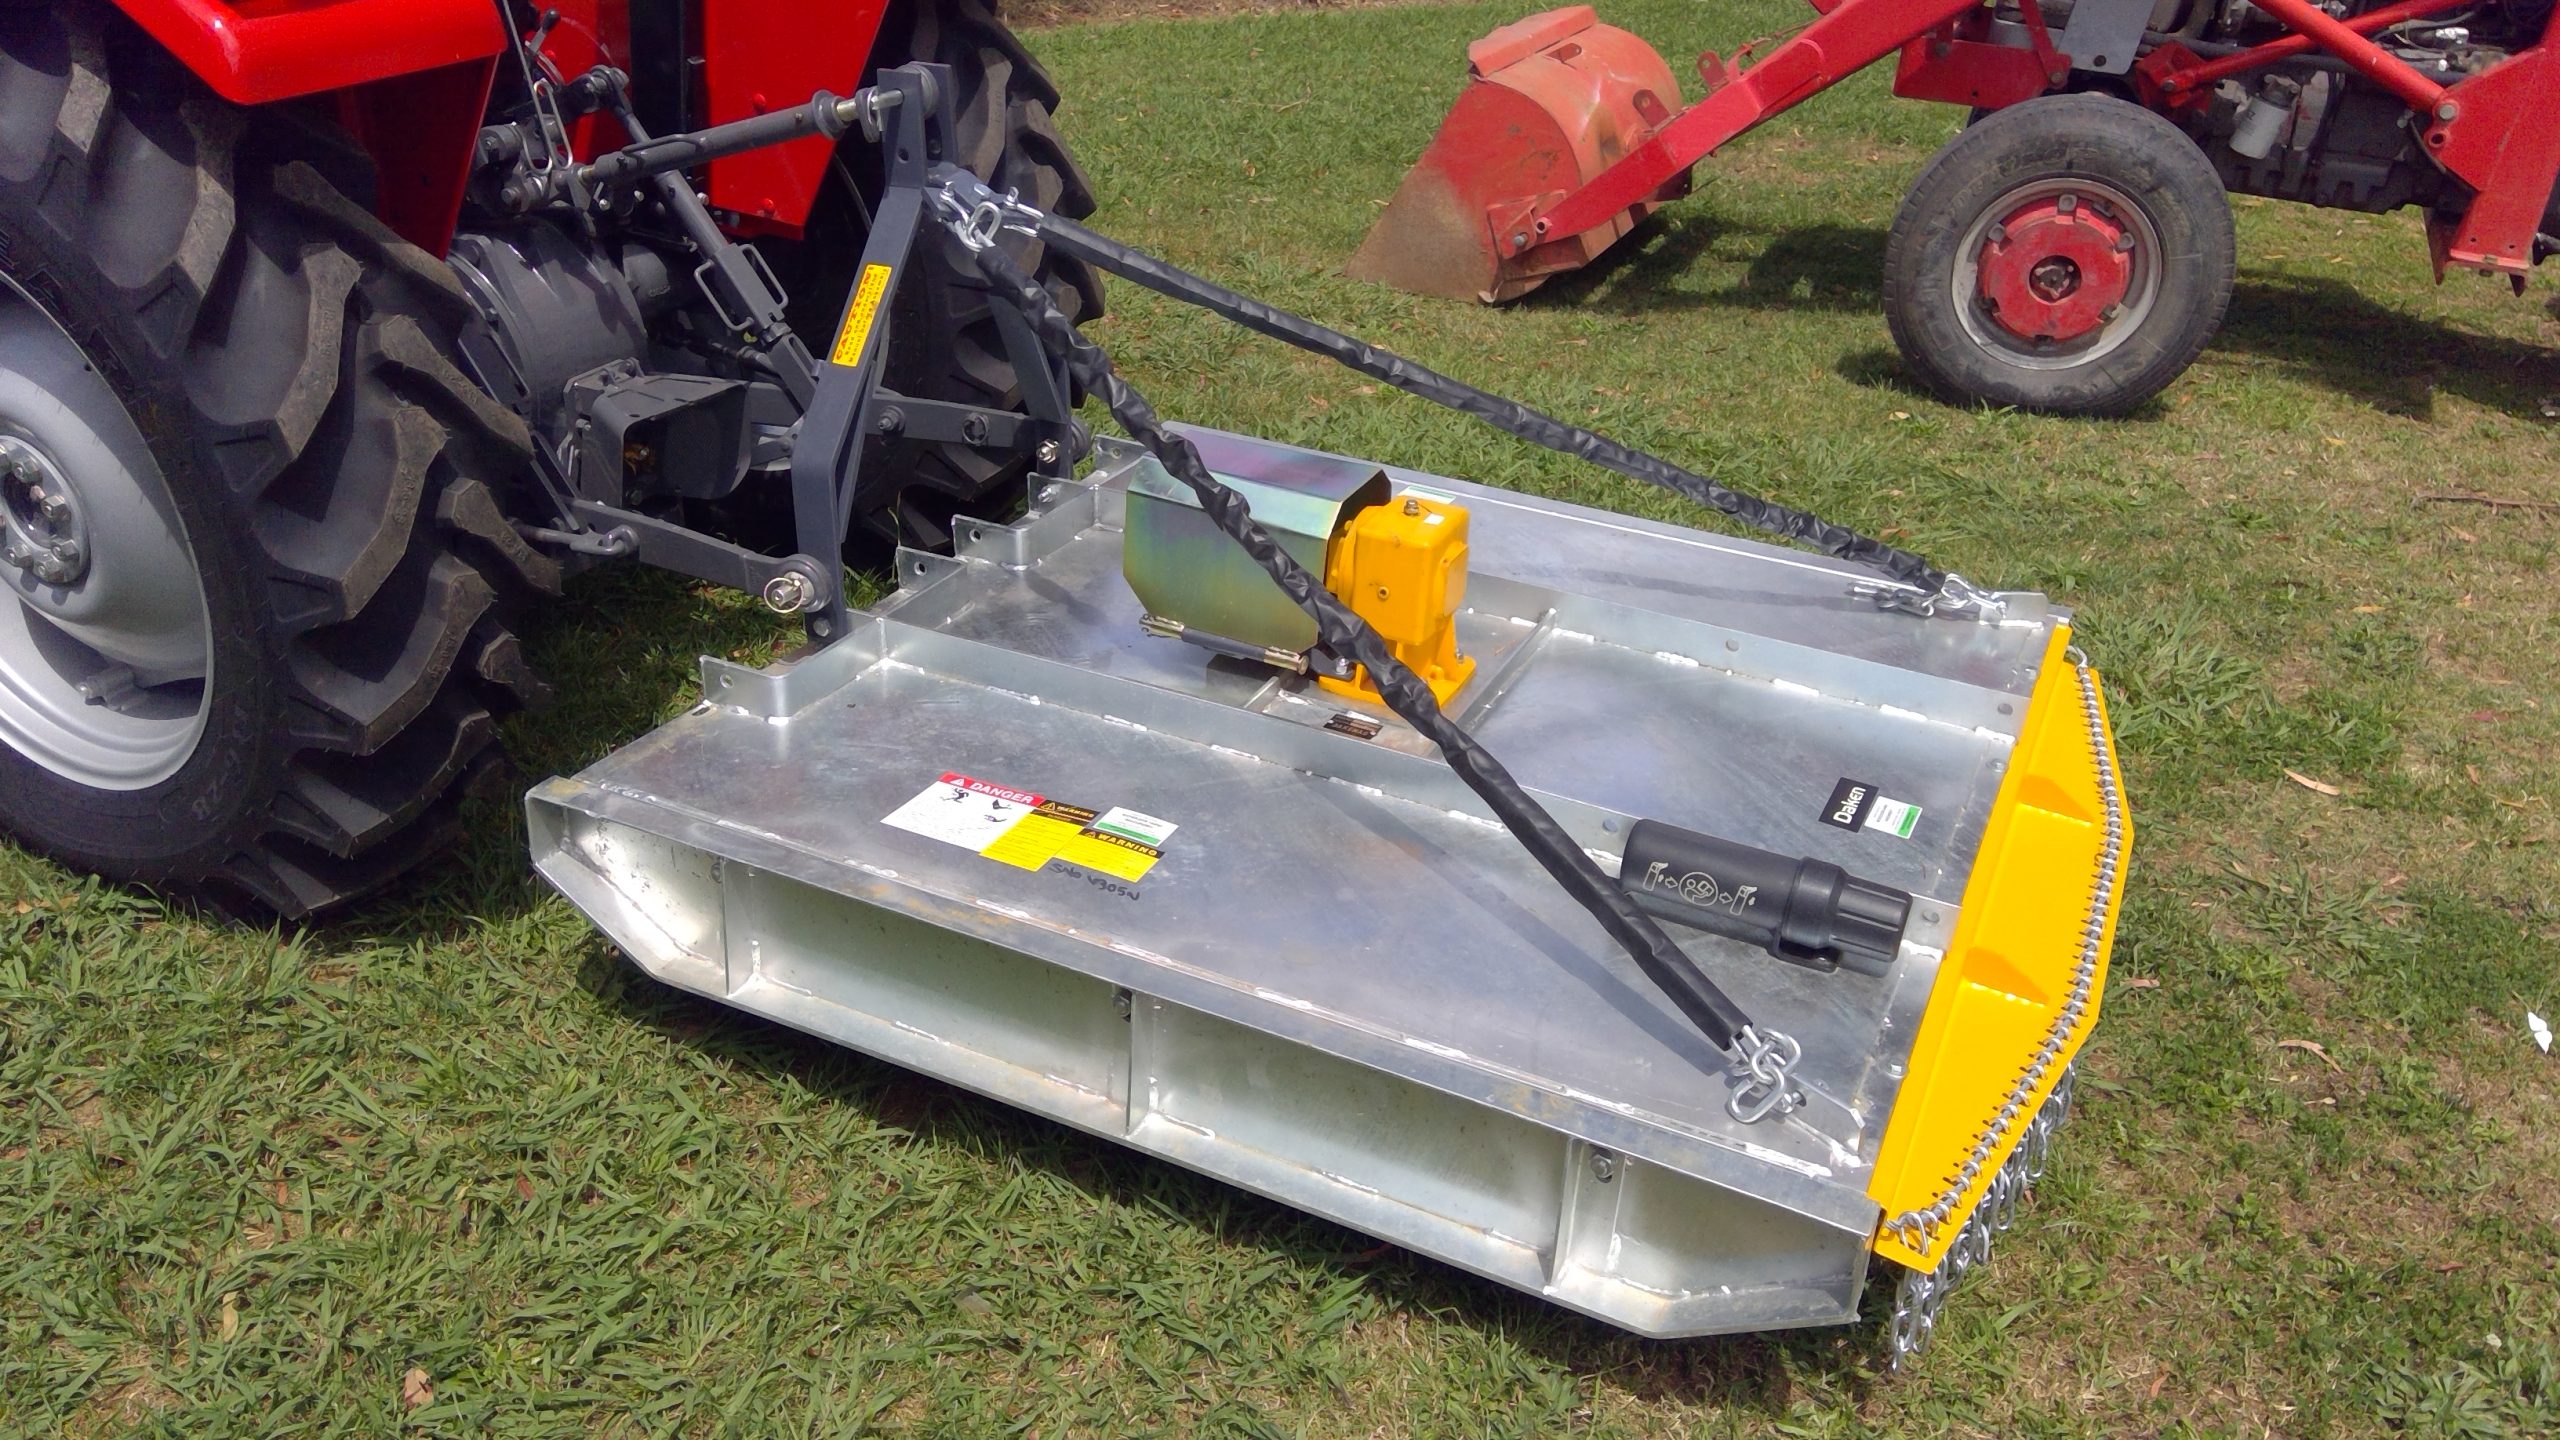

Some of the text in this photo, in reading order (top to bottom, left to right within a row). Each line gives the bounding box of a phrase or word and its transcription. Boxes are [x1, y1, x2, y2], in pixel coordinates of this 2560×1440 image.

[969, 782, 1034, 804] DANGER
[1832, 786, 1867, 825] Daken
[1098, 833, 1158, 856] WARNING
